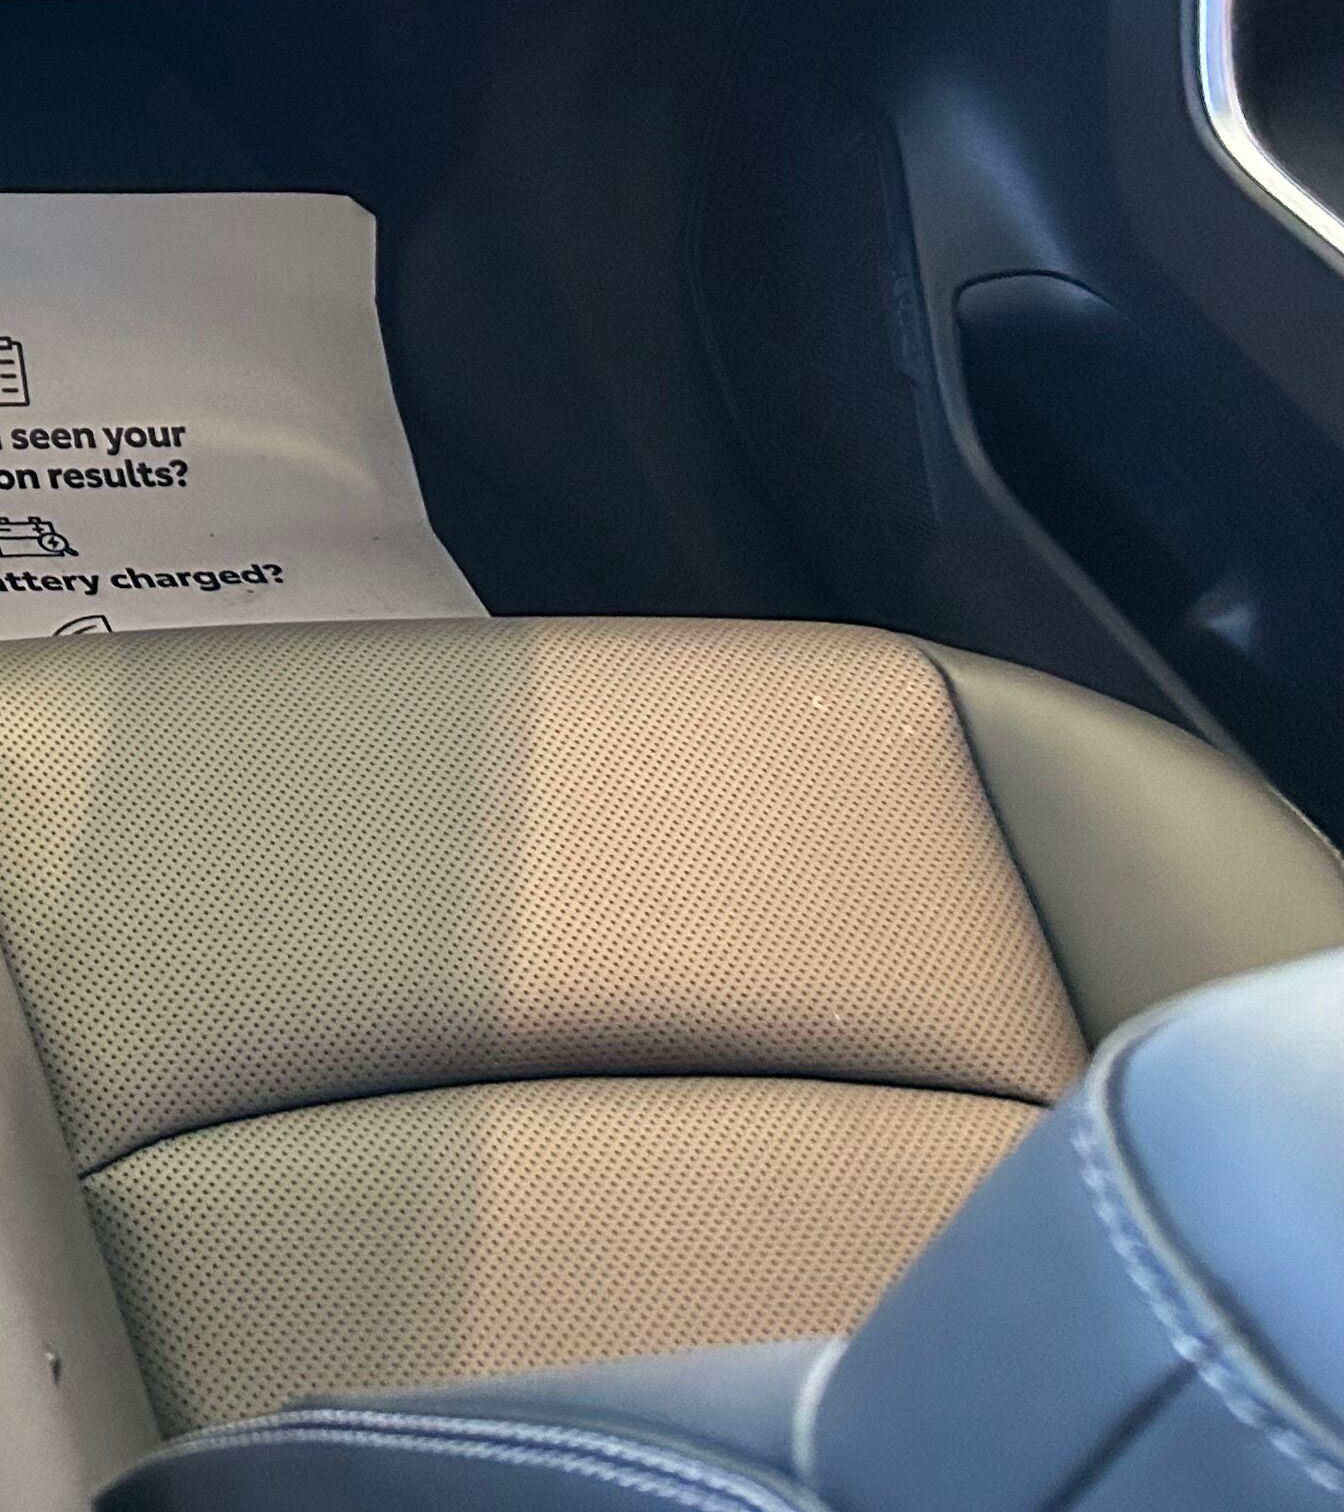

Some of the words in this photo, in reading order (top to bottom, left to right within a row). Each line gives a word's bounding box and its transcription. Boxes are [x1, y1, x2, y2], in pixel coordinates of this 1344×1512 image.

[11, 426, 96, 451] seen
[103, 424, 187, 456] your
[46, 459, 189, 490] results?
[109, 563, 285, 592] charged?
